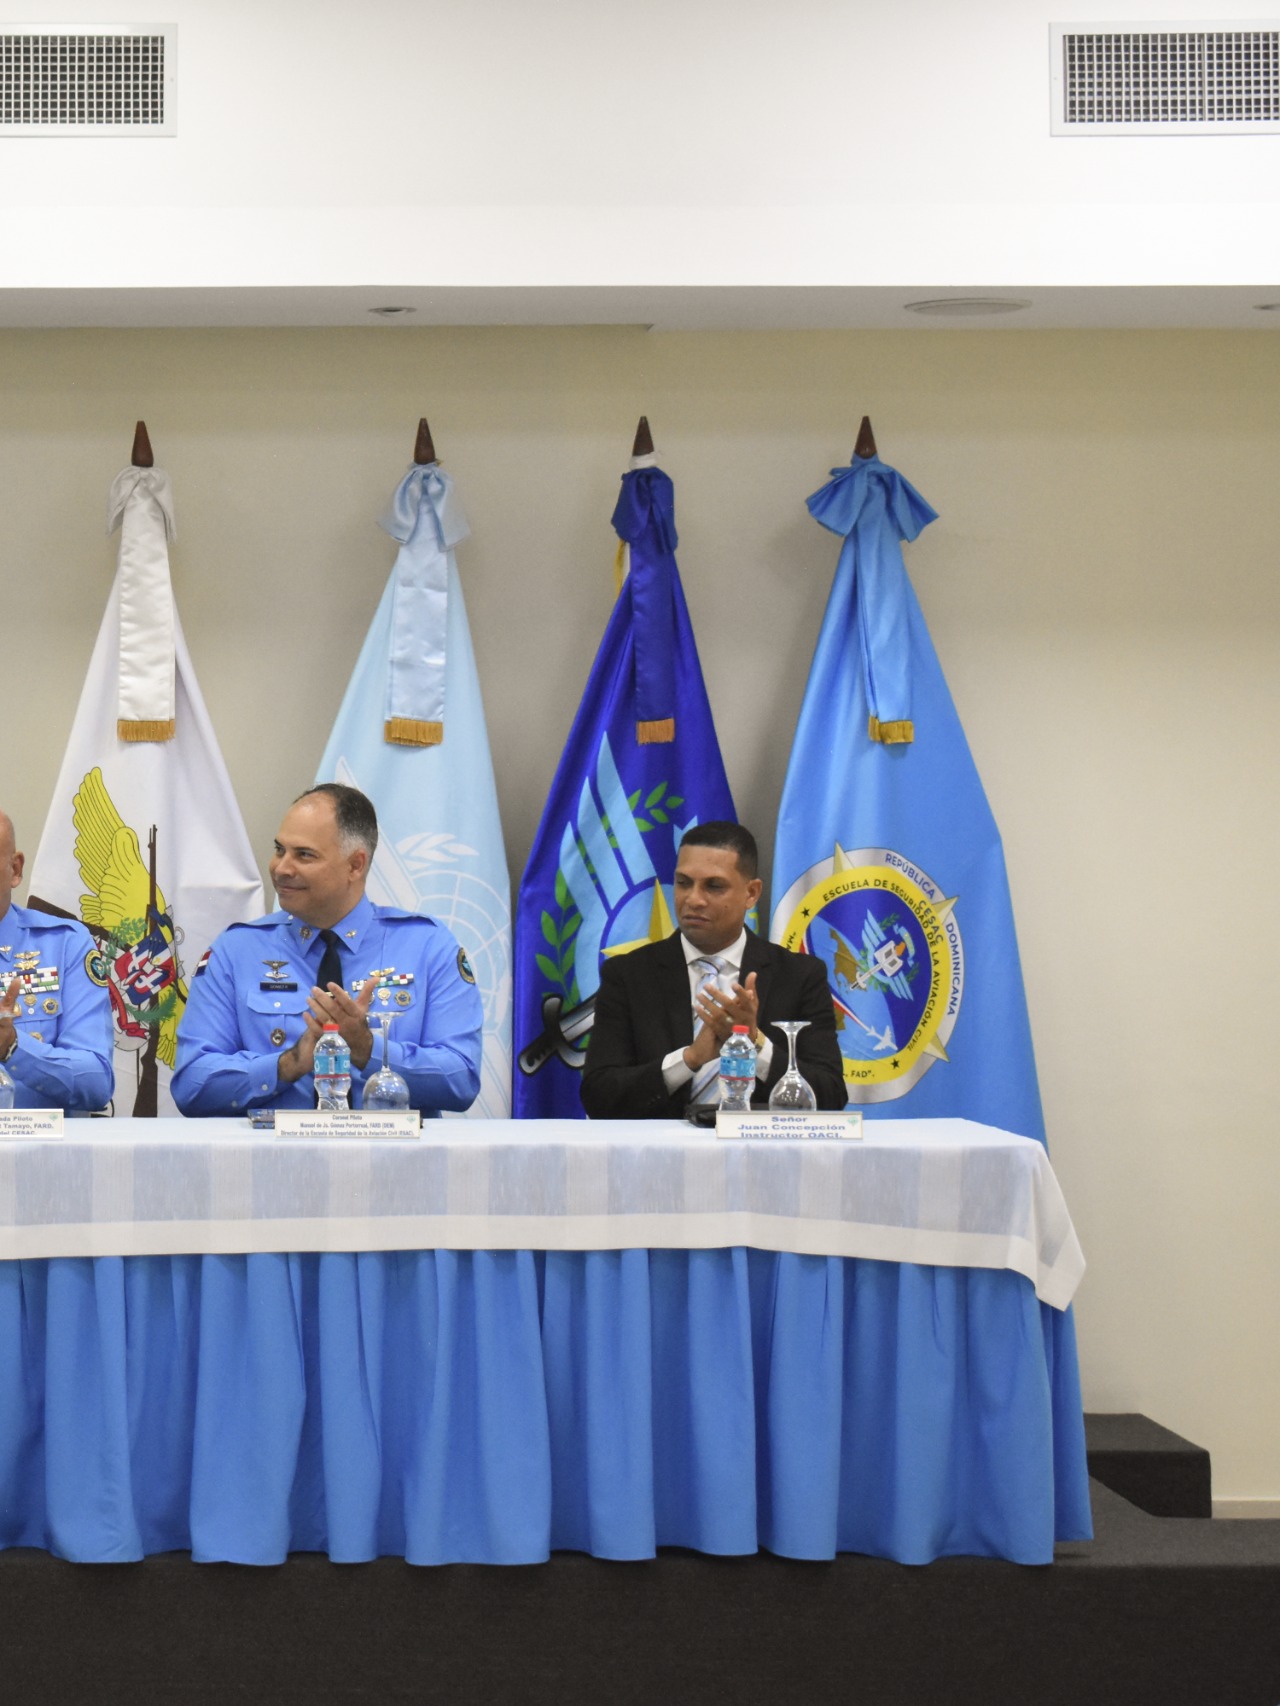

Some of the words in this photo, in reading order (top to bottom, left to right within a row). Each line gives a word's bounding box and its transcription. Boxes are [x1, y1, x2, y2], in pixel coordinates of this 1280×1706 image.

[823, 879, 870, 903] ESCUELA
[874, 879, 888, 888] DE
[885, 853, 935, 900] REPÚBLICA
[890, 883, 929, 929] SEGURIDAD
[918, 900, 944, 944] CESAC
[926, 931, 936, 947] DE
[931, 951, 940, 967] LA
[945, 922, 961, 1017] DOMINICANA
[921, 972, 940, 1029] AVIACIÓN
[907, 1028, 923, 1052] CIVIL
